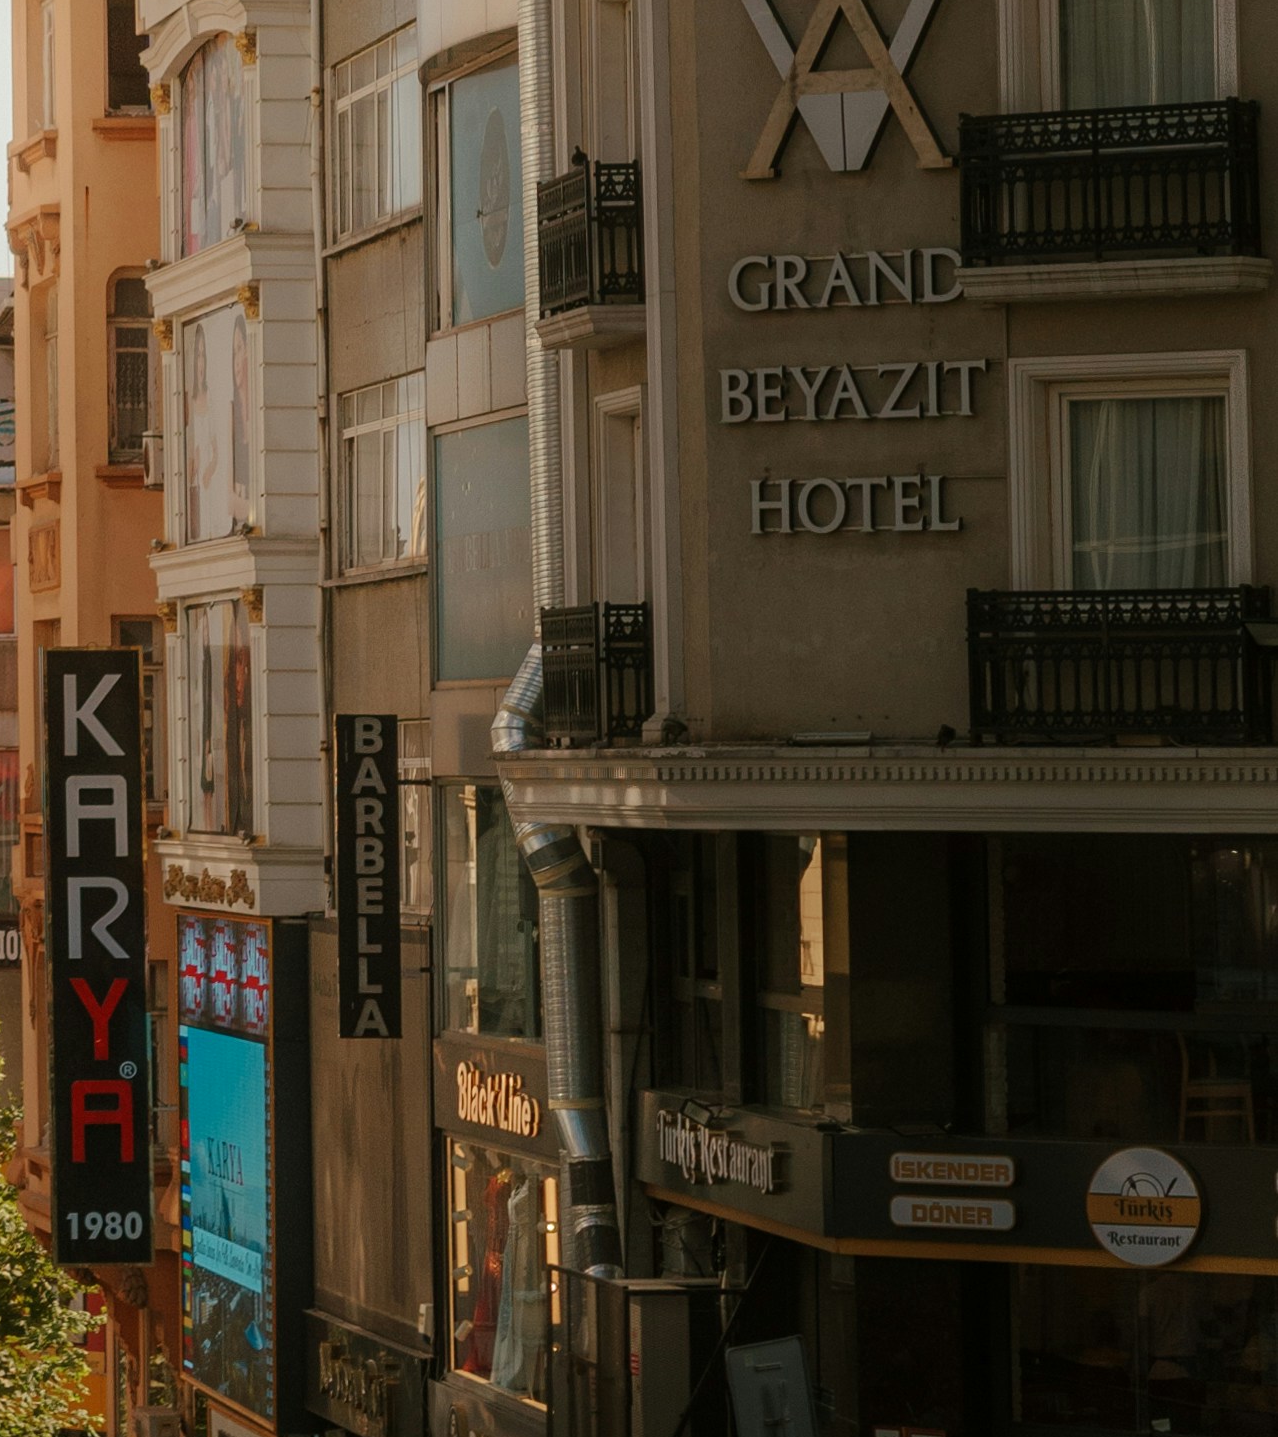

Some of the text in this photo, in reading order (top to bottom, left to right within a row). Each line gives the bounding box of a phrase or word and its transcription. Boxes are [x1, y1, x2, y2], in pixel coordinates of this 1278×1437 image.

[727, 247, 964, 312] GRAND
[719, 358, 987, 424] BEYAZIT
[750, 474, 962, 535] HOTEL
[351, 718, 390, 1038] BARBELLA
[62, 674, 135, 1164] KARYA
[457, 1061, 496, 1127] Black
[207, 1136, 245, 1186] KARYA
[698, 1123, 775, 1194] Restaurant
[894, 1157, 1010, 1182] İSKENDER
[66, 1212, 143, 1242] 1980
[912, 1202, 993, 1226] DÖNER
[1107, 1230, 1182, 1248] Restaurant
[1114, 1199, 1173, 1223] Türkiş
